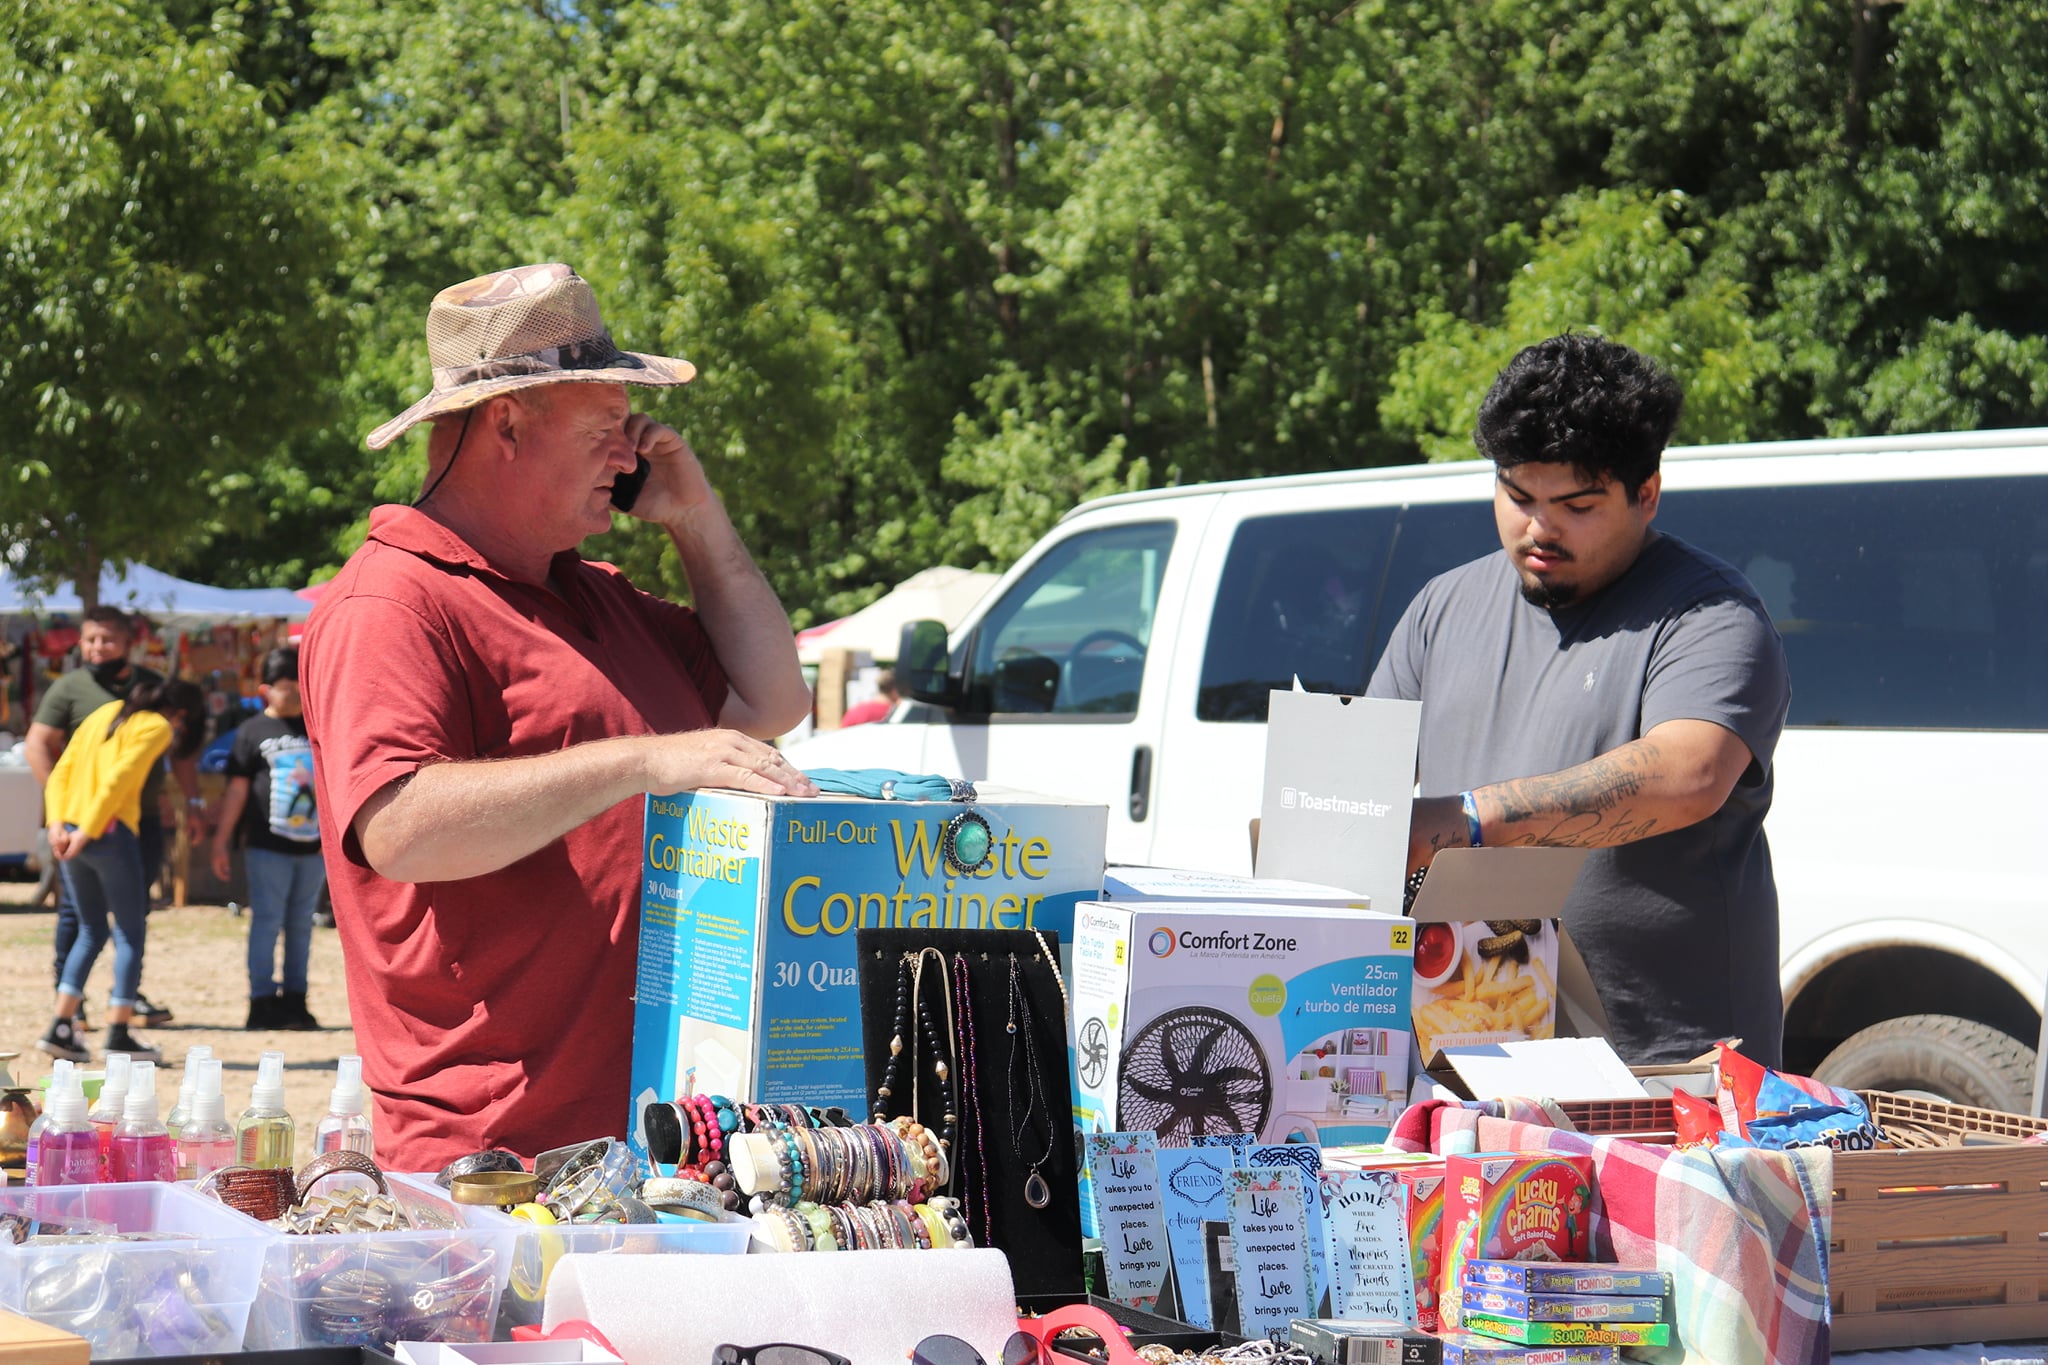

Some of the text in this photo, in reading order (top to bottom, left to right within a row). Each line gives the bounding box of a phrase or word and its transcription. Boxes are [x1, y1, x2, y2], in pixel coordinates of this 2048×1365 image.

[652, 800, 684, 818] Pull-Out
[1298, 791, 1390, 817] Toastmaster
[688, 804, 750, 850] Waste
[788, 820, 878, 844] Pull-Out
[890, 818, 1053, 879] Wste
[649, 833, 748, 886] Container
[646, 880, 684, 900] 30 Quart
[783, 875, 1044, 936] Container
[1179, 930, 1297, 951] Comfort Zone
[1221, 951, 1250, 959] Preferida
[773, 961, 803, 989] 30
[807, 960, 858, 992] Qua
[1364, 964, 1399, 980] 25cm
[1251, 992, 1282, 1004] Quieta
[1331, 983, 1398, 998] Ventilador
[1305, 1000, 1397, 1014] turbo de mesa
[1111, 1156, 1138, 1180] Life
[1104, 1183, 1153, 1195] takes you to
[1177, 1174, 1223, 1189] FRIENDS
[1338, 1191, 1388, 1210] HOME
[1514, 1178, 1559, 1211] Lucky
[1108, 1201, 1155, 1213] unexpected
[1251, 1193, 1279, 1218] Life
[1120, 1220, 1150, 1232] places.
[1243, 1223, 1295, 1234] takes you to
[1506, 1205, 1562, 1238] Charms
[1123, 1232, 1155, 1255] Love
[1513, 1230, 1557, 1245] Soft Baked Bars
[1246, 1241, 1296, 1255] unexpected
[1348, 1244, 1389, 1261] Memories
[1119, 1260, 1161, 1272] brings you
[1258, 1261, 1289, 1274] places.
[1355, 1271, 1390, 1287] Friends
[1576, 1277, 1613, 1291] CRUNCH
[1260, 1275, 1293, 1300] Love
[1254, 1304, 1299, 1317] brings you
[1364, 1298, 1399, 1319] Family
[1575, 1304, 1609, 1318] CRUNCH
[1462, 1315, 1485, 1331] SOUR
[1484, 1320, 1509, 1335] PATCH
[1554, 1328, 1586, 1344] SOUR
[1585, 1328, 1619, 1344] PATCH
[1526, 1350, 1565, 1365] CRUNCH
